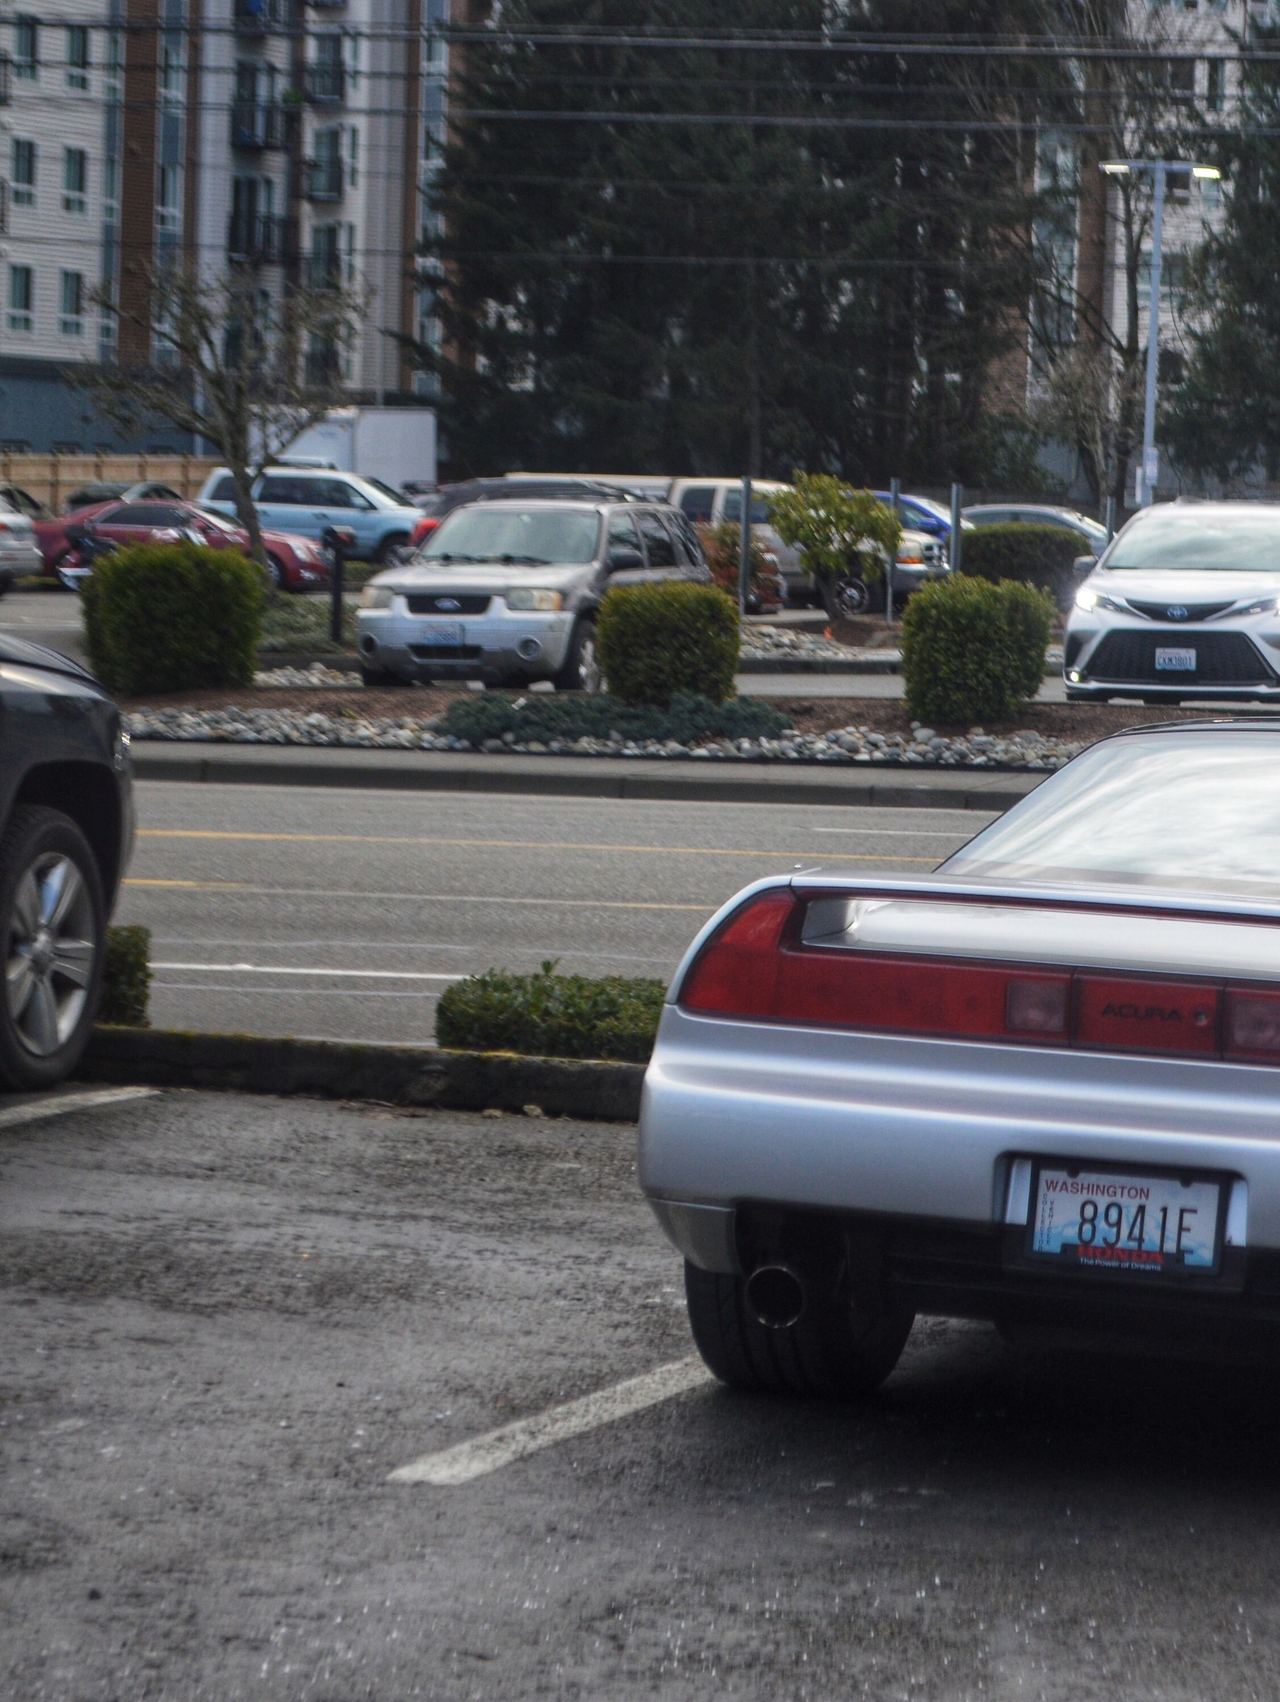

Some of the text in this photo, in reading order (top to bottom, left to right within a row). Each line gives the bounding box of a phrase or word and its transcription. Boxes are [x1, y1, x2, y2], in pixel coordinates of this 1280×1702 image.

[1102, 1003, 1181, 1022] ACURA
[1044, 1179, 1150, 1200] WASHINGTON
[1046, 1200, 1055, 1246] VEHICLE
[1077, 1200, 1198, 1255] 8941E
[1077, 1245, 1165, 1265] HONDA
[1080, 1257, 1094, 1266] The
[1095, 1259, 1119, 1268] Power
[1130, 1262, 1162, 1272] Dreams
